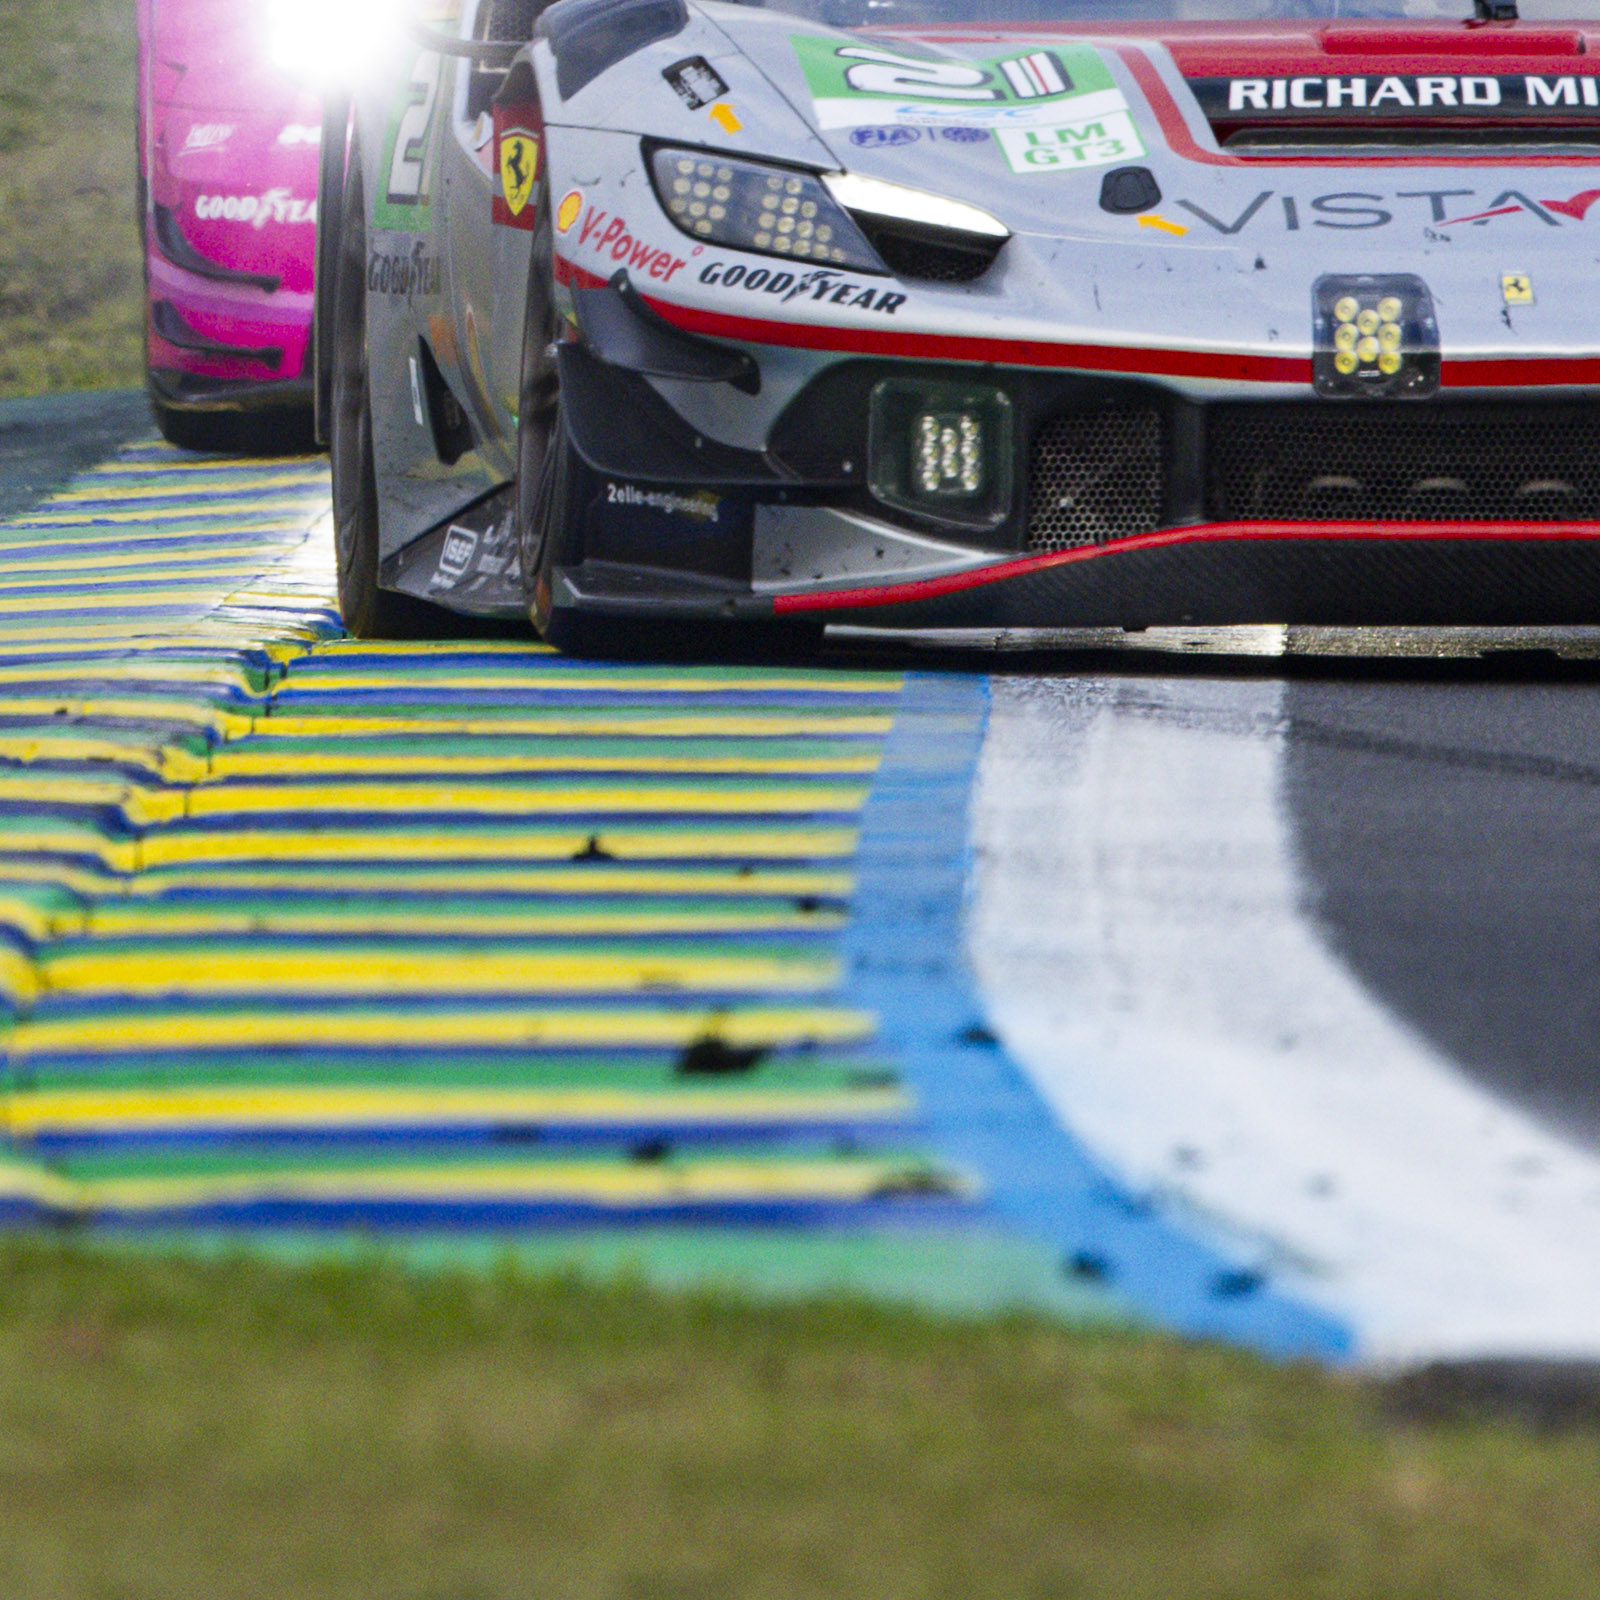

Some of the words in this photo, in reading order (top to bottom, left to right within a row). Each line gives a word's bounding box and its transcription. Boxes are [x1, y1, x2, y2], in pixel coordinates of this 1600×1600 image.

[1228, 76, 1500, 111] RICHARD
[1025, 122, 1106, 147] LM
[1024, 139, 1125, 166] GT3
[579, 205, 687, 283] V-Power
[699, 262, 908, 315] GOODYEAR
